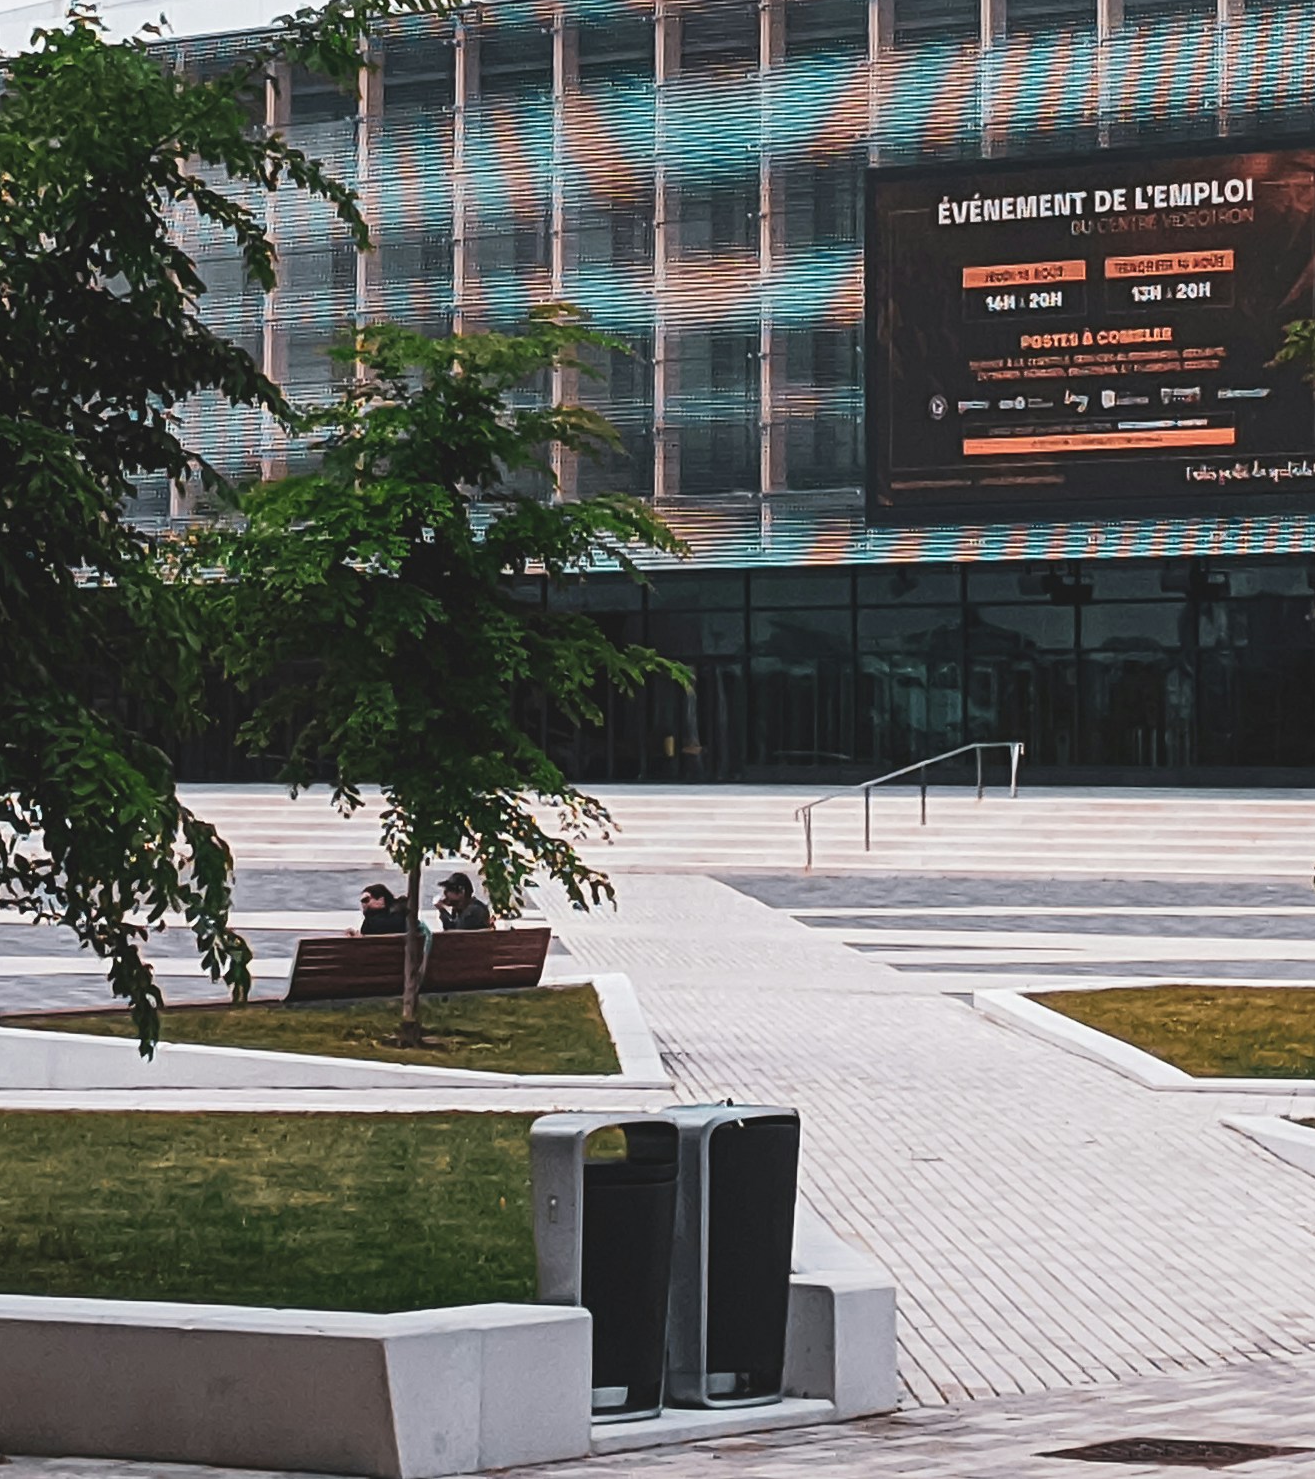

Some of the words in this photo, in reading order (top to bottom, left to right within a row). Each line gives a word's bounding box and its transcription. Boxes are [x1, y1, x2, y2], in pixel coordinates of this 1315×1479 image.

[937, 190, 1088, 225] ÉVÉNEMENT
[1094, 188, 1128, 213] DE
[1134, 177, 1254, 210] L'EMPLOI
[1175, 281, 1211, 299] 20H
[1029, 291, 1063, 309] 20H
